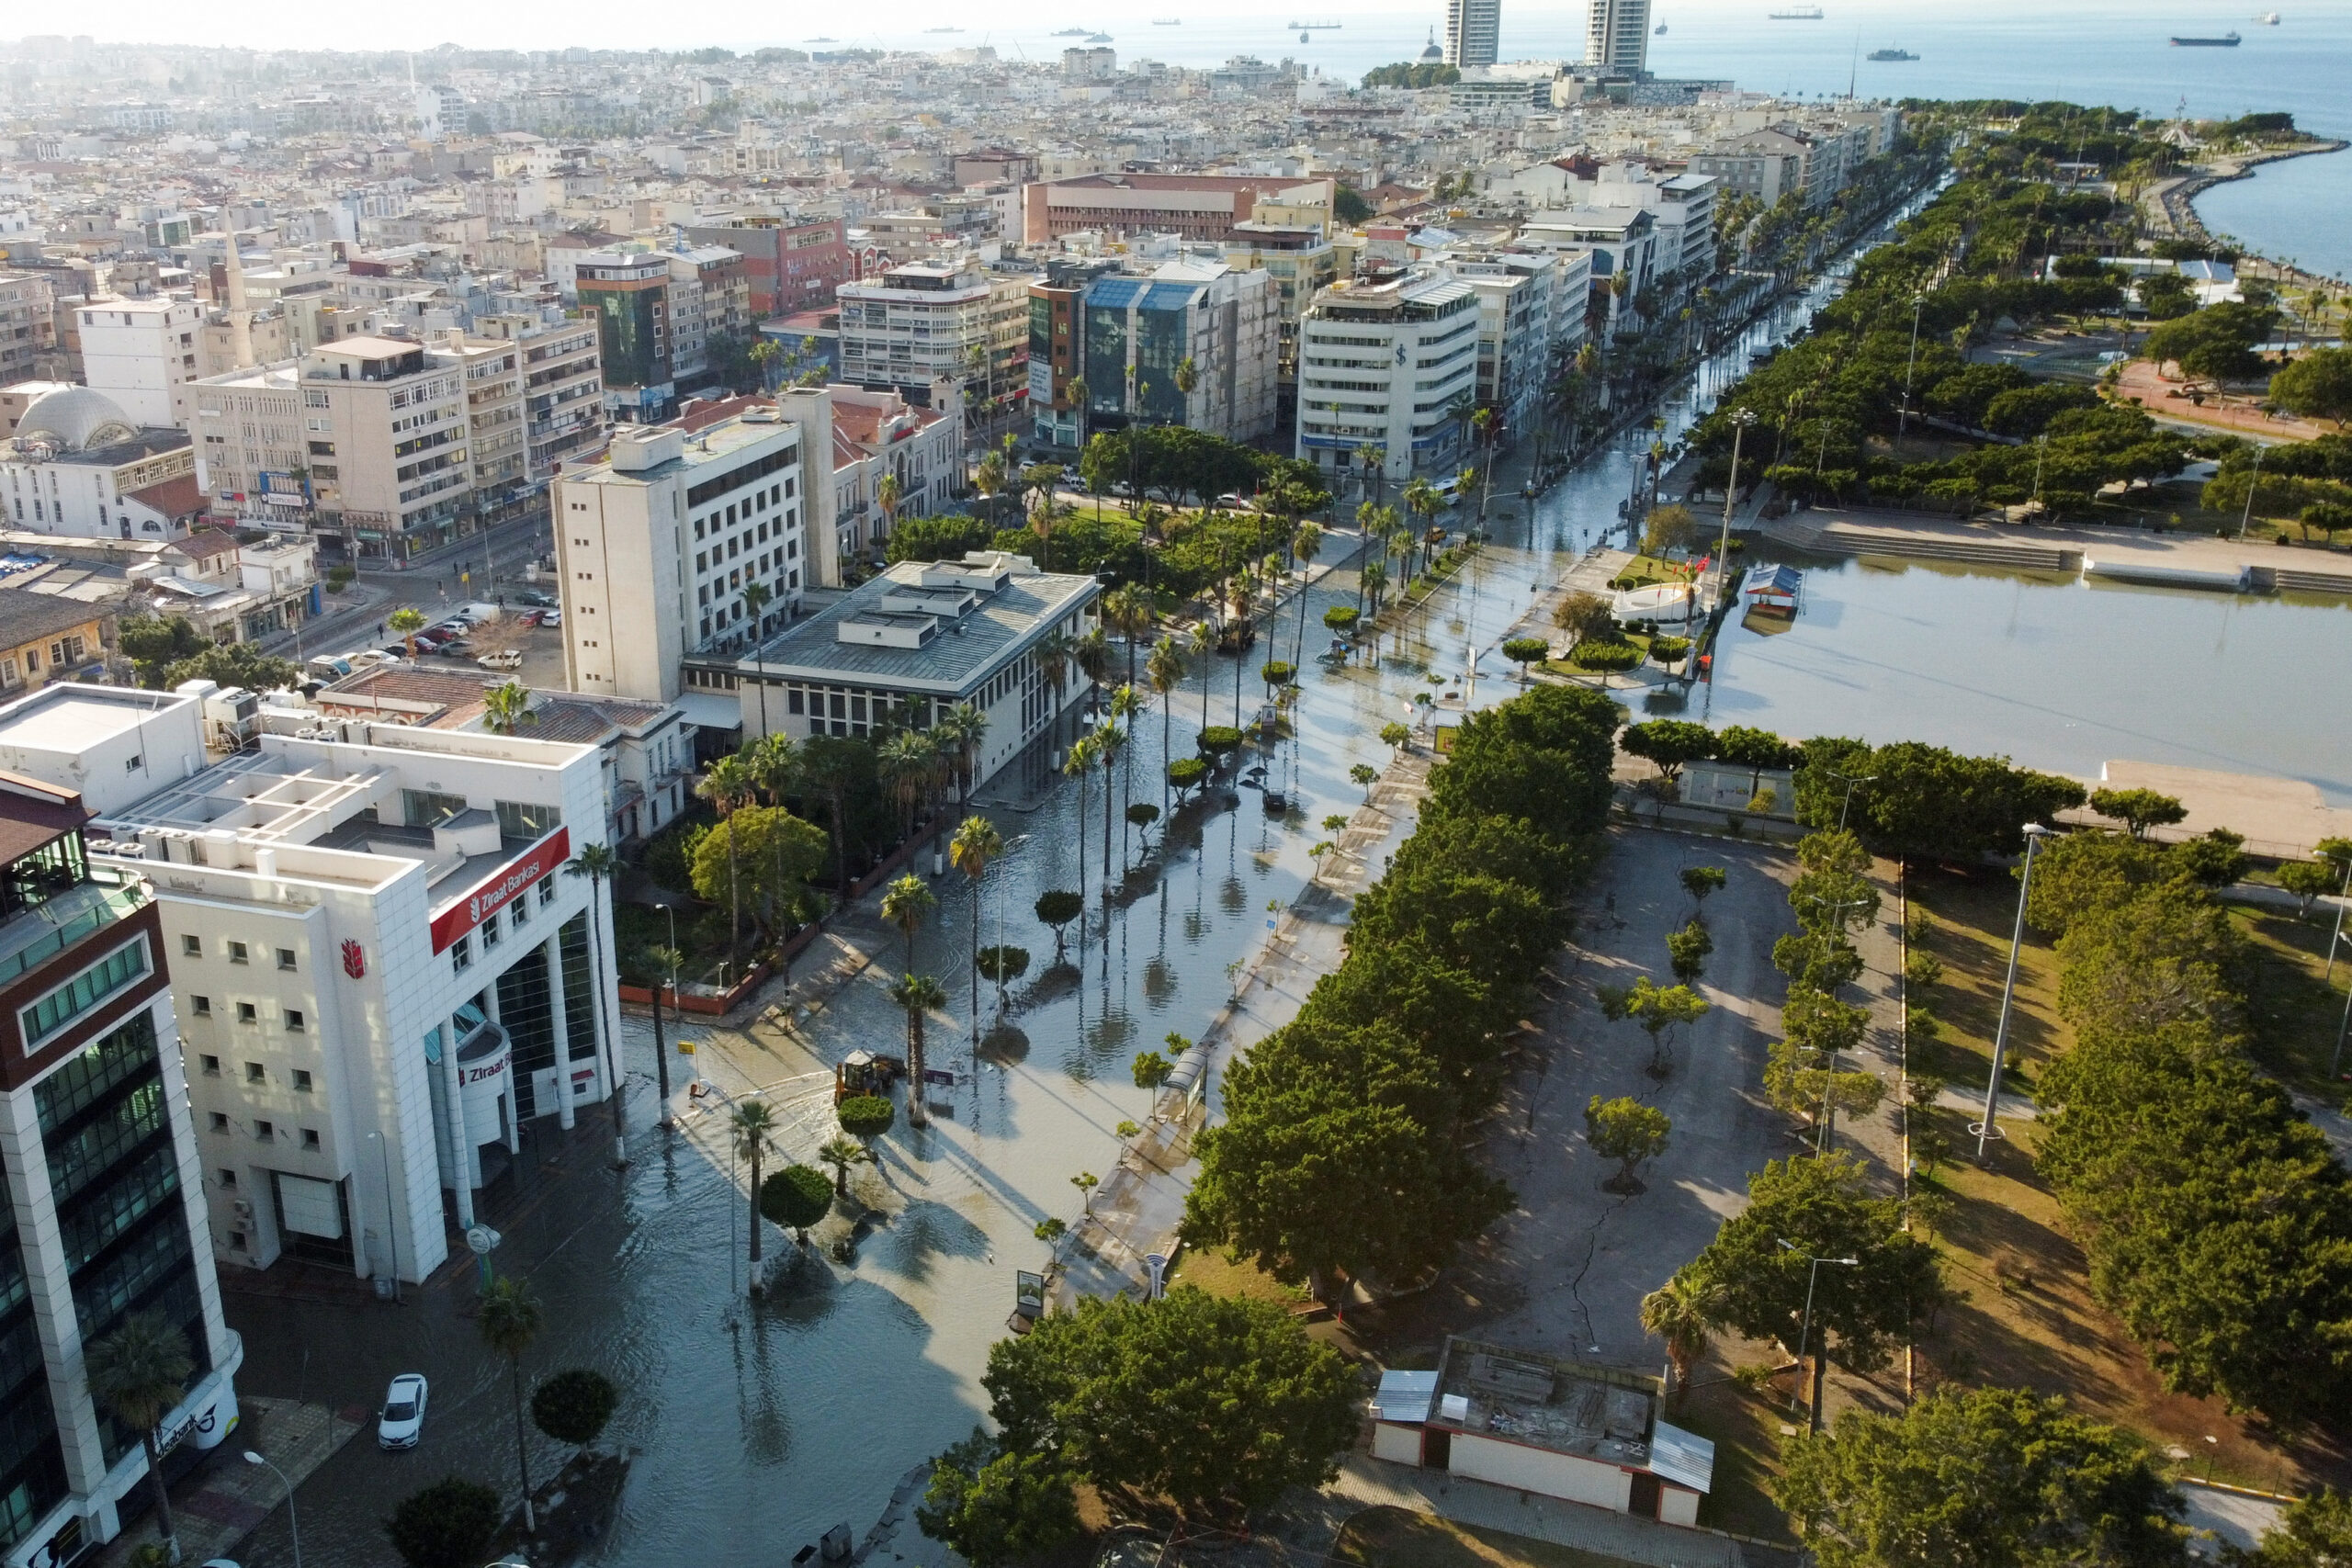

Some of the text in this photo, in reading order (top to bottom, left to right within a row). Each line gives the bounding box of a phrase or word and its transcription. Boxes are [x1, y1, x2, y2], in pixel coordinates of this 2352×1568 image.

[481, 860, 540, 912] Ziraat Bankası
[469, 1058, 504, 1082] Ziraat
